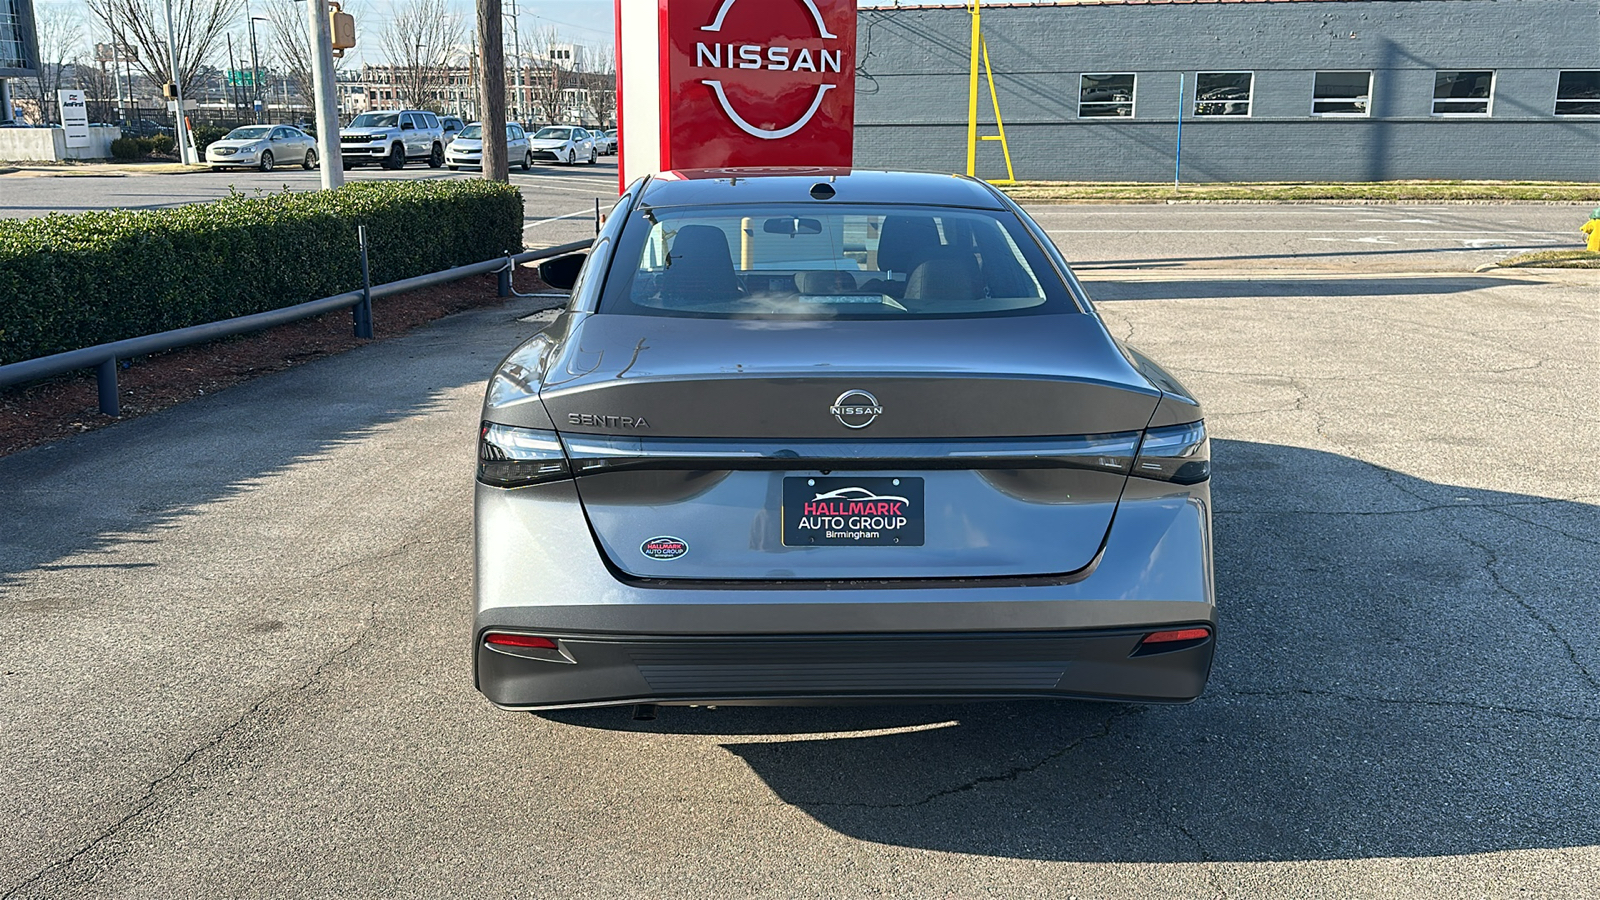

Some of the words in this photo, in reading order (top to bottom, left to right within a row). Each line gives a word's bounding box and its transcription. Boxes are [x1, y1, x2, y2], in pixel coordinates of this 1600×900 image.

[696, 42, 841, 73] NISSAN
[831, 407, 882, 415] NISSAN
[568, 412, 651, 429] SENTRA
[804, 502, 902, 515] HALLMARK
[798, 516, 844, 530] AUTO
[848, 516, 907, 530] GROUP
[825, 530, 880, 540] Birmingham
